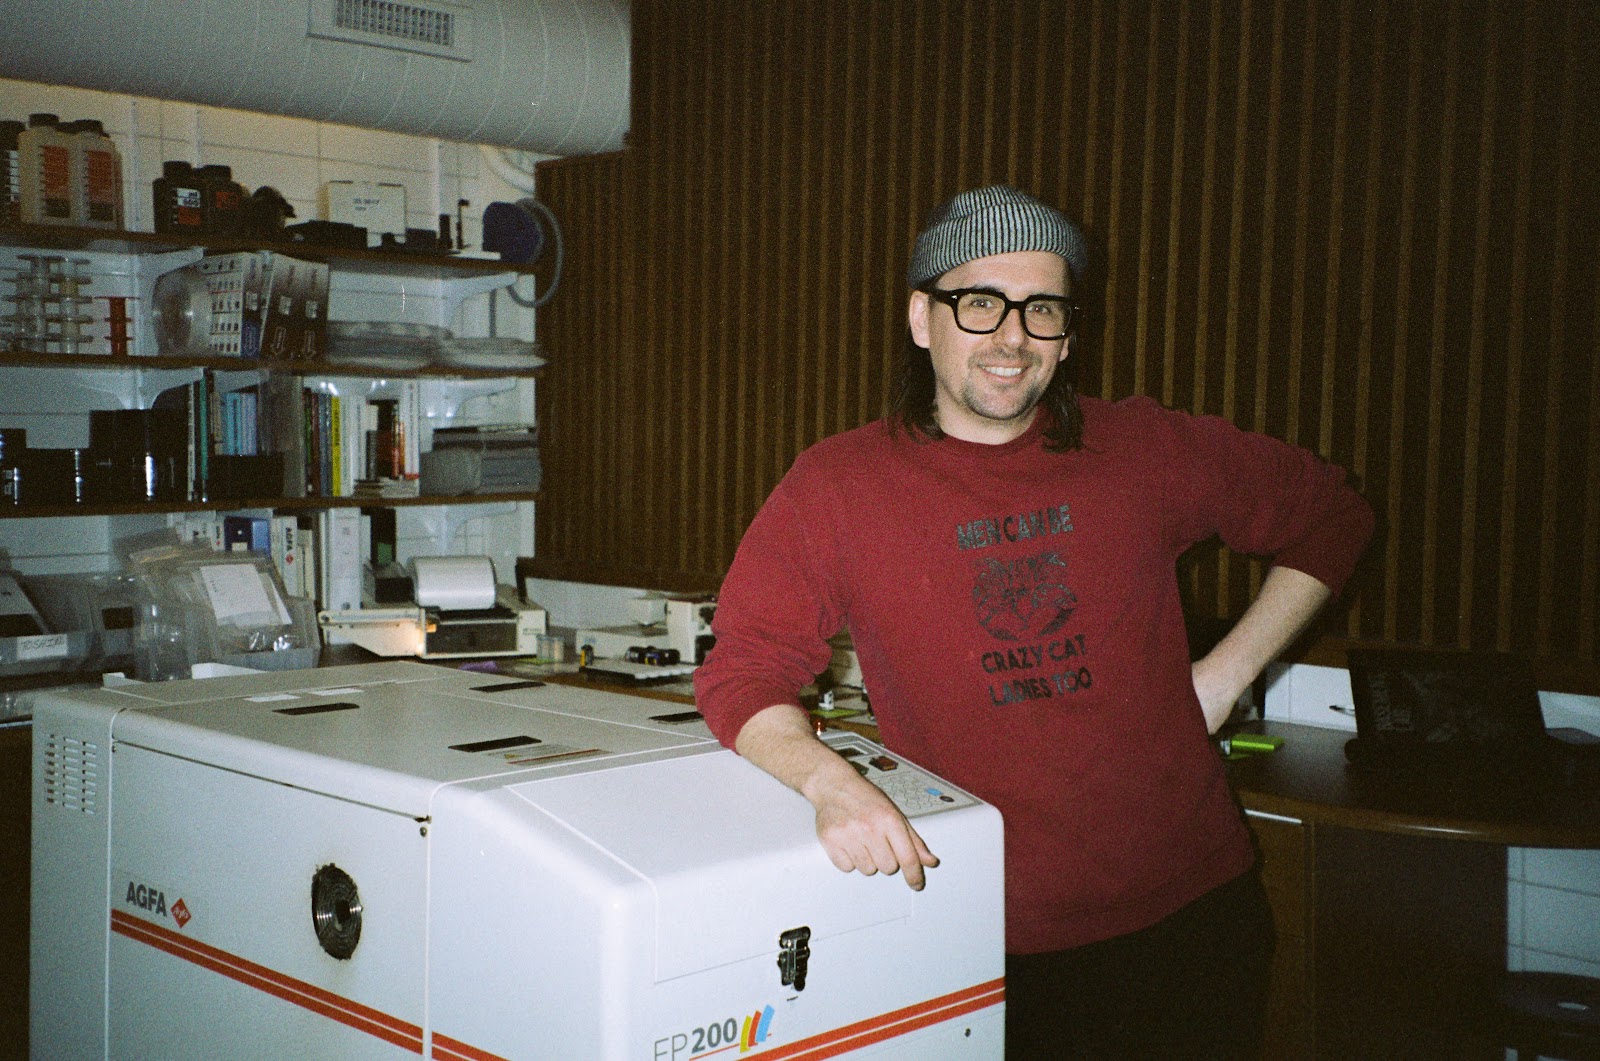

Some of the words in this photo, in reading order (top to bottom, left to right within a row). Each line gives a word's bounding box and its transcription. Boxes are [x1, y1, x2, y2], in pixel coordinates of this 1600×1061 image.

[957, 519, 1001, 550] MEN
[1003, 511, 1045, 542] CAN
[1047, 505, 1073, 534] BE
[981, 645, 1043, 673] CRAZY
[1048, 634, 1085, 661] CAT
[989, 678, 1051, 706] LADIES
[1052, 667, 1092, 696] TOO
[126, 881, 167, 917] AGFA
